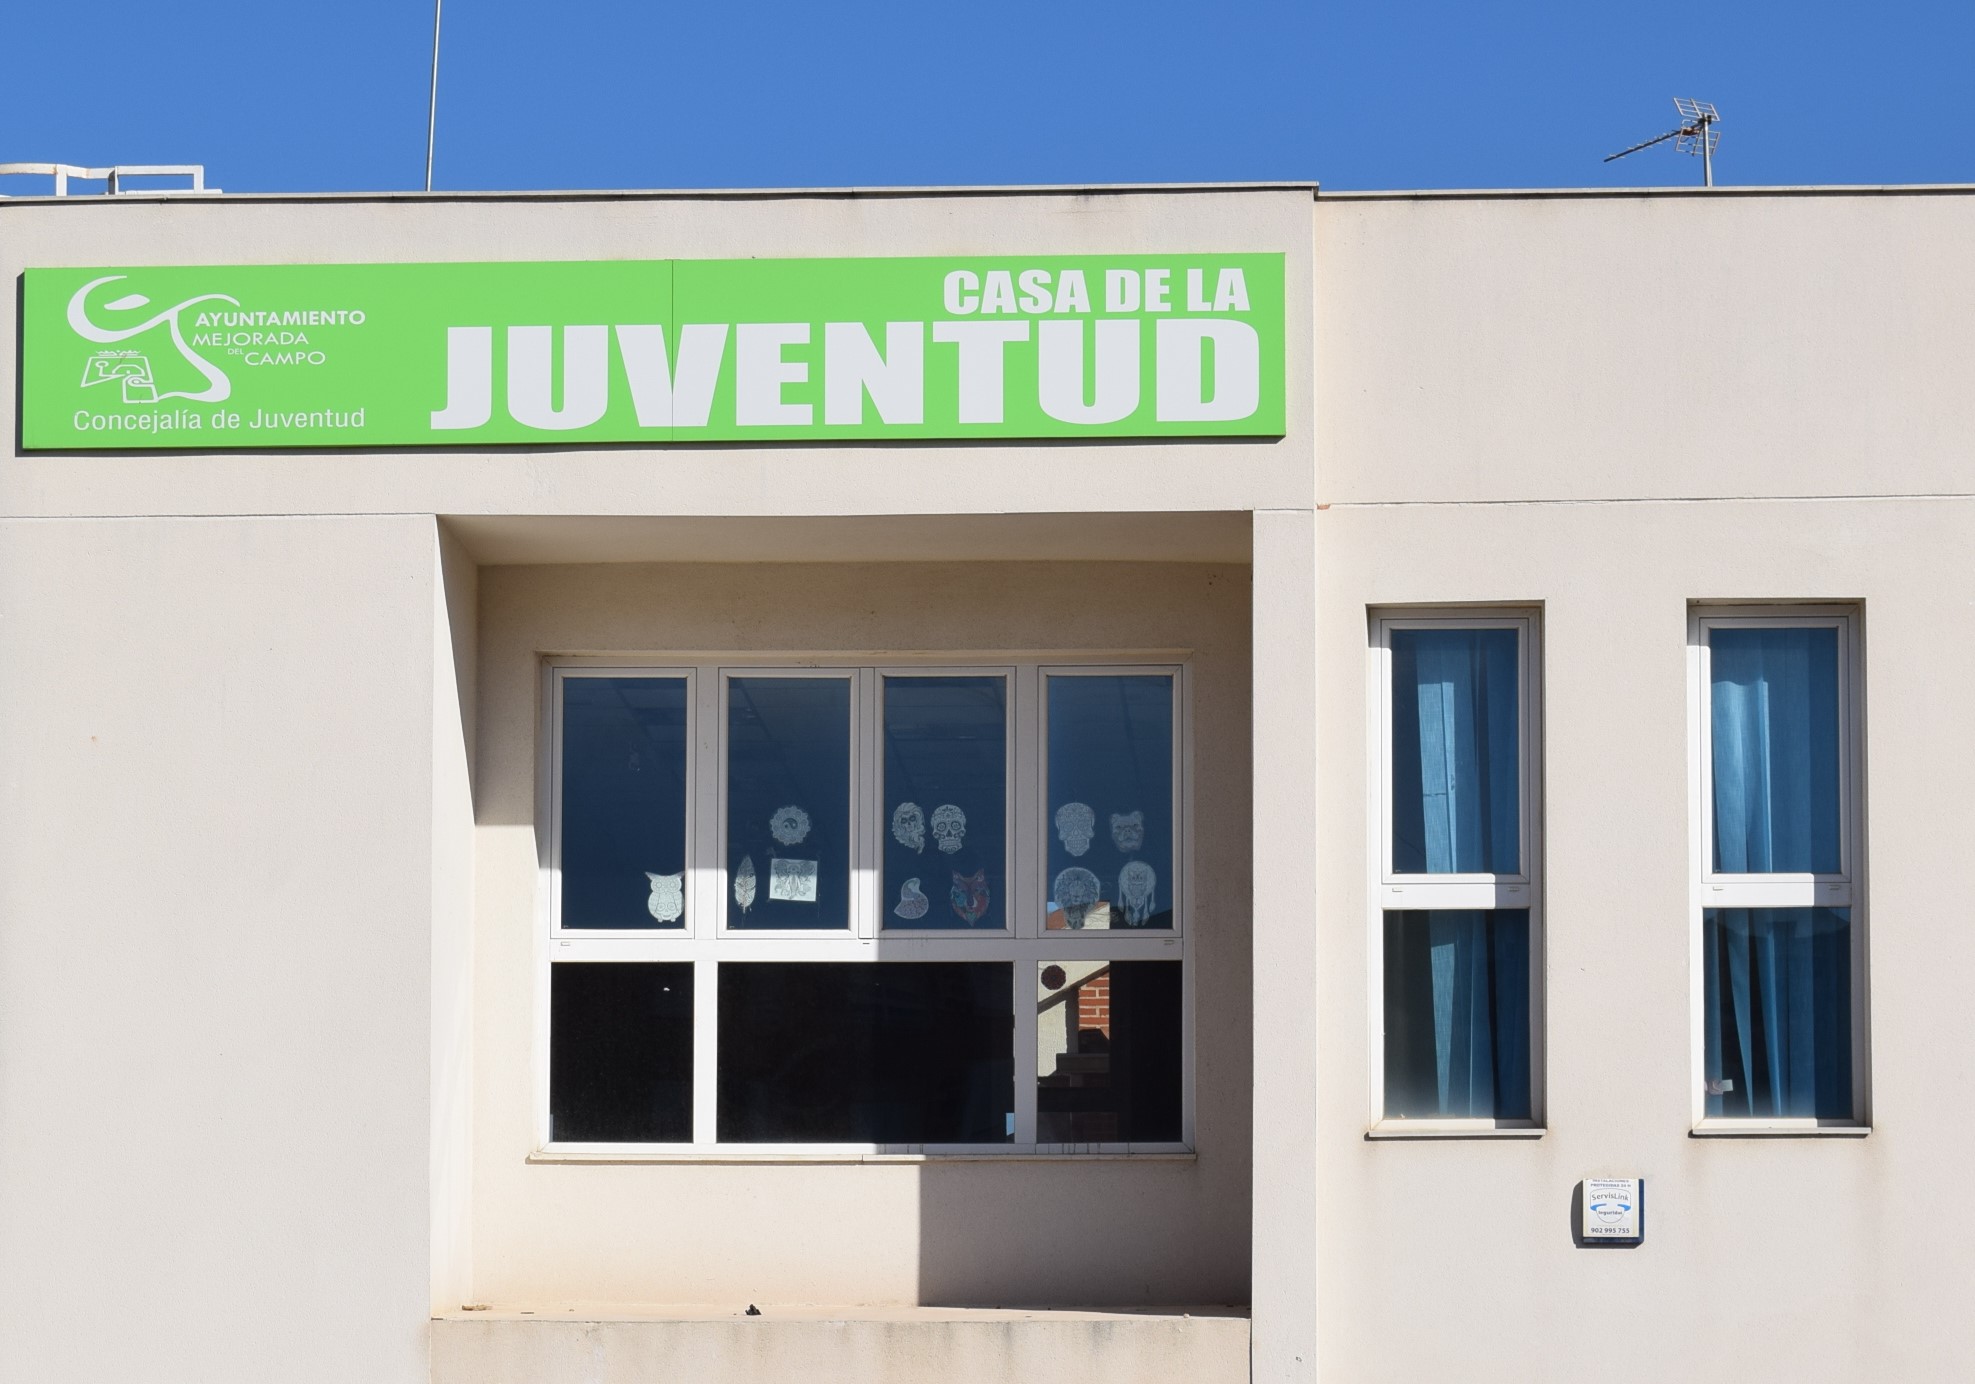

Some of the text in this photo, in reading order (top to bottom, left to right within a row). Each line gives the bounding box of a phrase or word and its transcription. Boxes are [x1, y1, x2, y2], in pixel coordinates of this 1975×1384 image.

[943, 267, 1251, 315] CASA DE LA
[195, 310, 366, 327] AYUNTAMIENTO
[192, 332, 309, 347] MEJORADA
[244, 351, 326, 366] CAMPO
[430, 318, 1260, 431] JUVENTUD
[73, 407, 365, 434] Concejalía de Juventud
[1591, 1192, 1629, 1201] ServisLink
